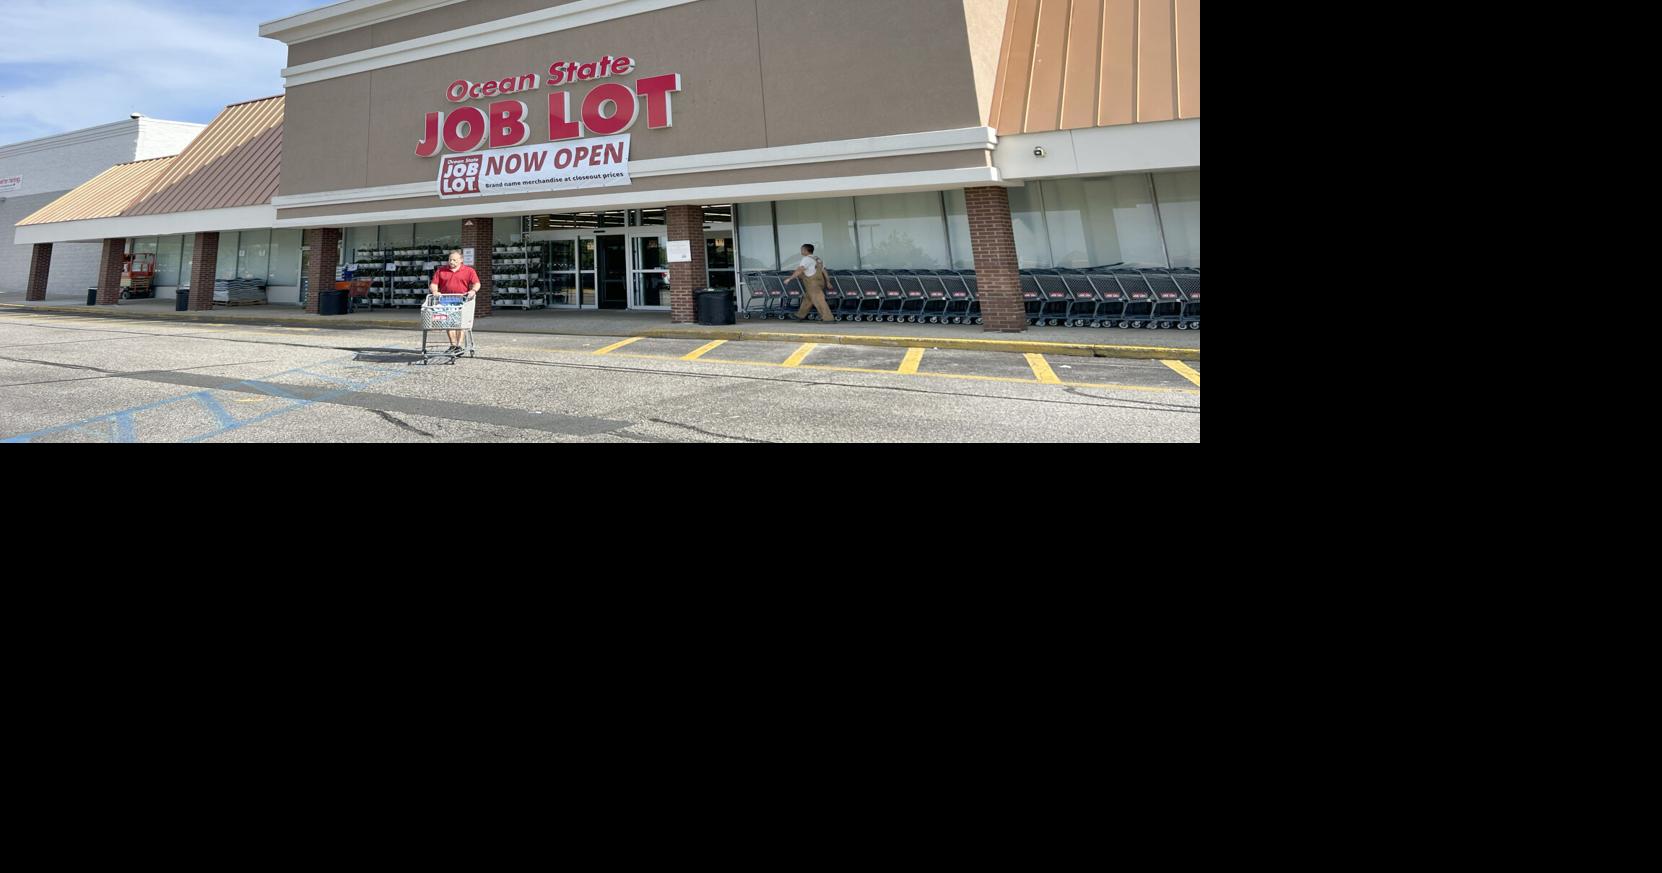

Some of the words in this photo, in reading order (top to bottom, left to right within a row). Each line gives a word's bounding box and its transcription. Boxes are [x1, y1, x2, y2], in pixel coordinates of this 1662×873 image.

[446, 73, 540, 103] Ocean
[547, 55, 635, 86] State
[415, 100, 530, 158] JOB
[548, 73, 681, 141] LOT
[443, 162, 480, 178] JOB
[485, 151, 548, 176] NOW
[554, 142, 624, 169] OPEN
[522, 177, 563, 186] merchandise
[602, 171, 624, 179] prices
